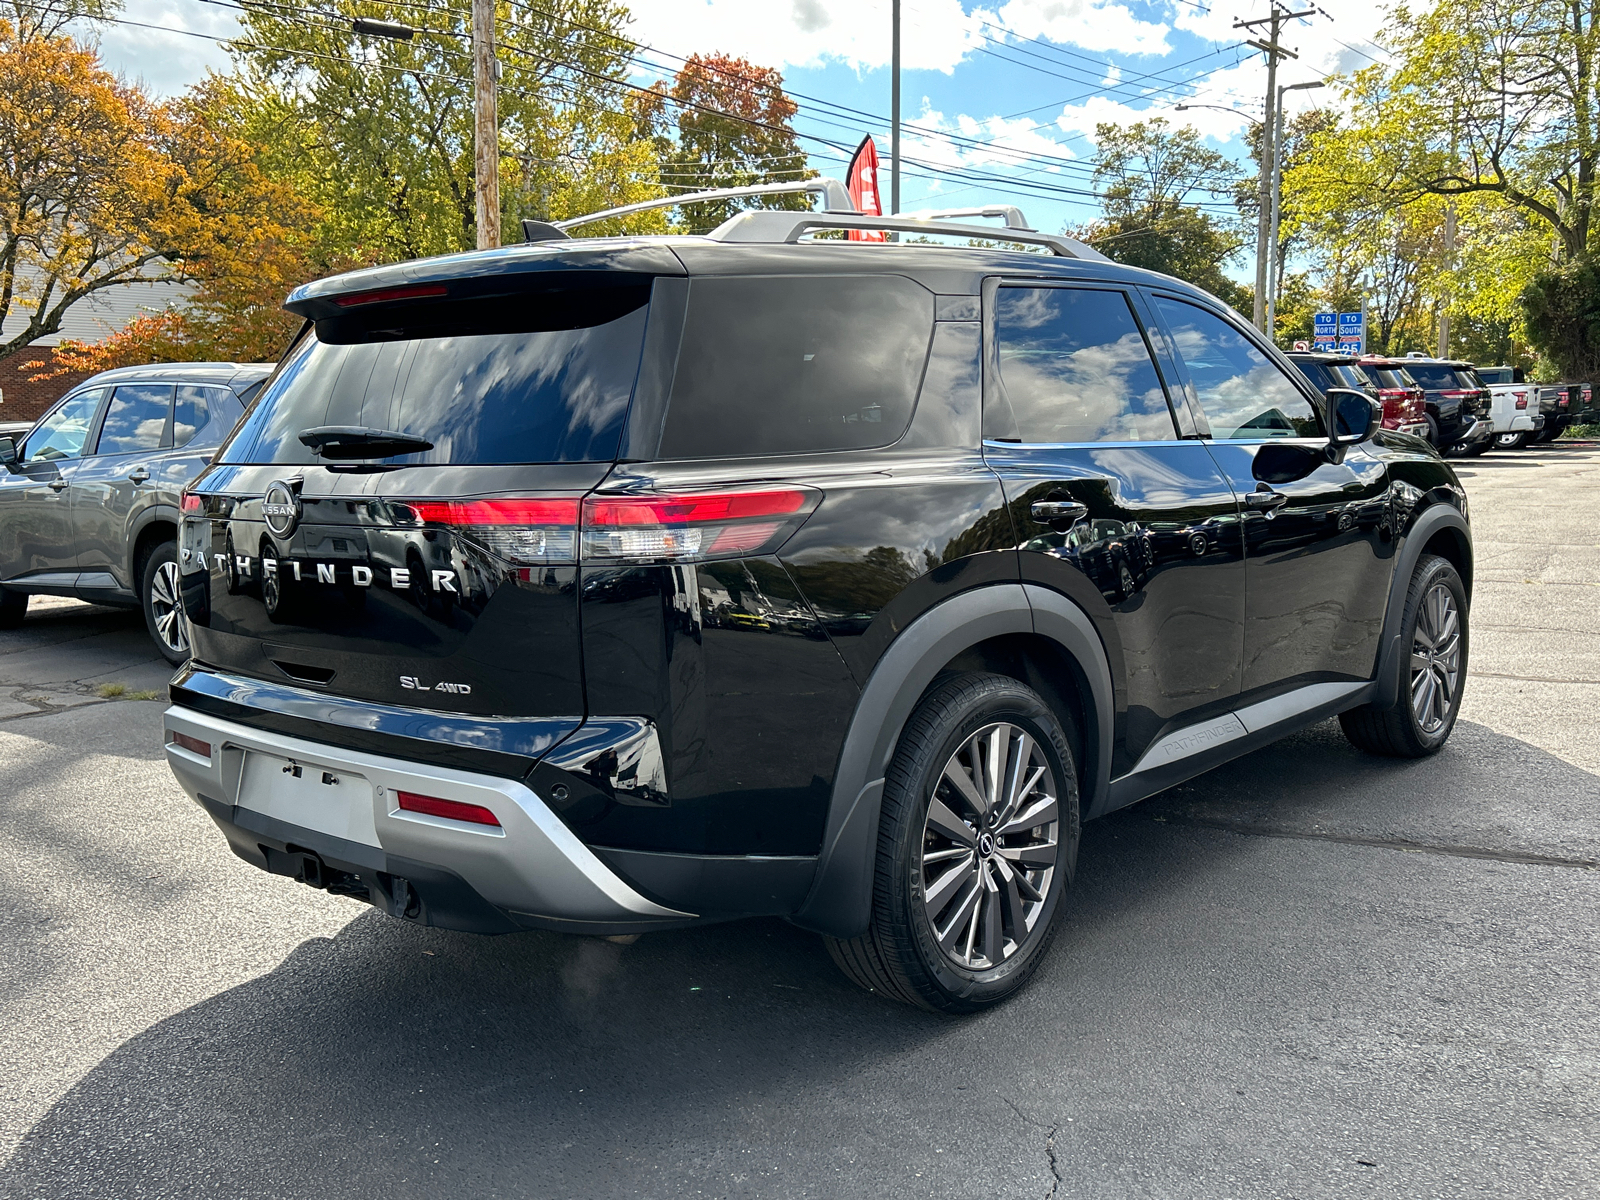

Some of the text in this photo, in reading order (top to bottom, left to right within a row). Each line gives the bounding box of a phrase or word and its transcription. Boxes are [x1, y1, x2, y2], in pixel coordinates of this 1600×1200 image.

[1315, 326, 1336, 335] NORTH
[1340, 326, 1361, 335] SOUTH
[261, 505, 296, 516] NISSAN
[181, 548, 458, 593] PATHFINDER
[399, 675, 472, 695] SL 4WD
[1161, 720, 1242, 756] PATHFINDER
